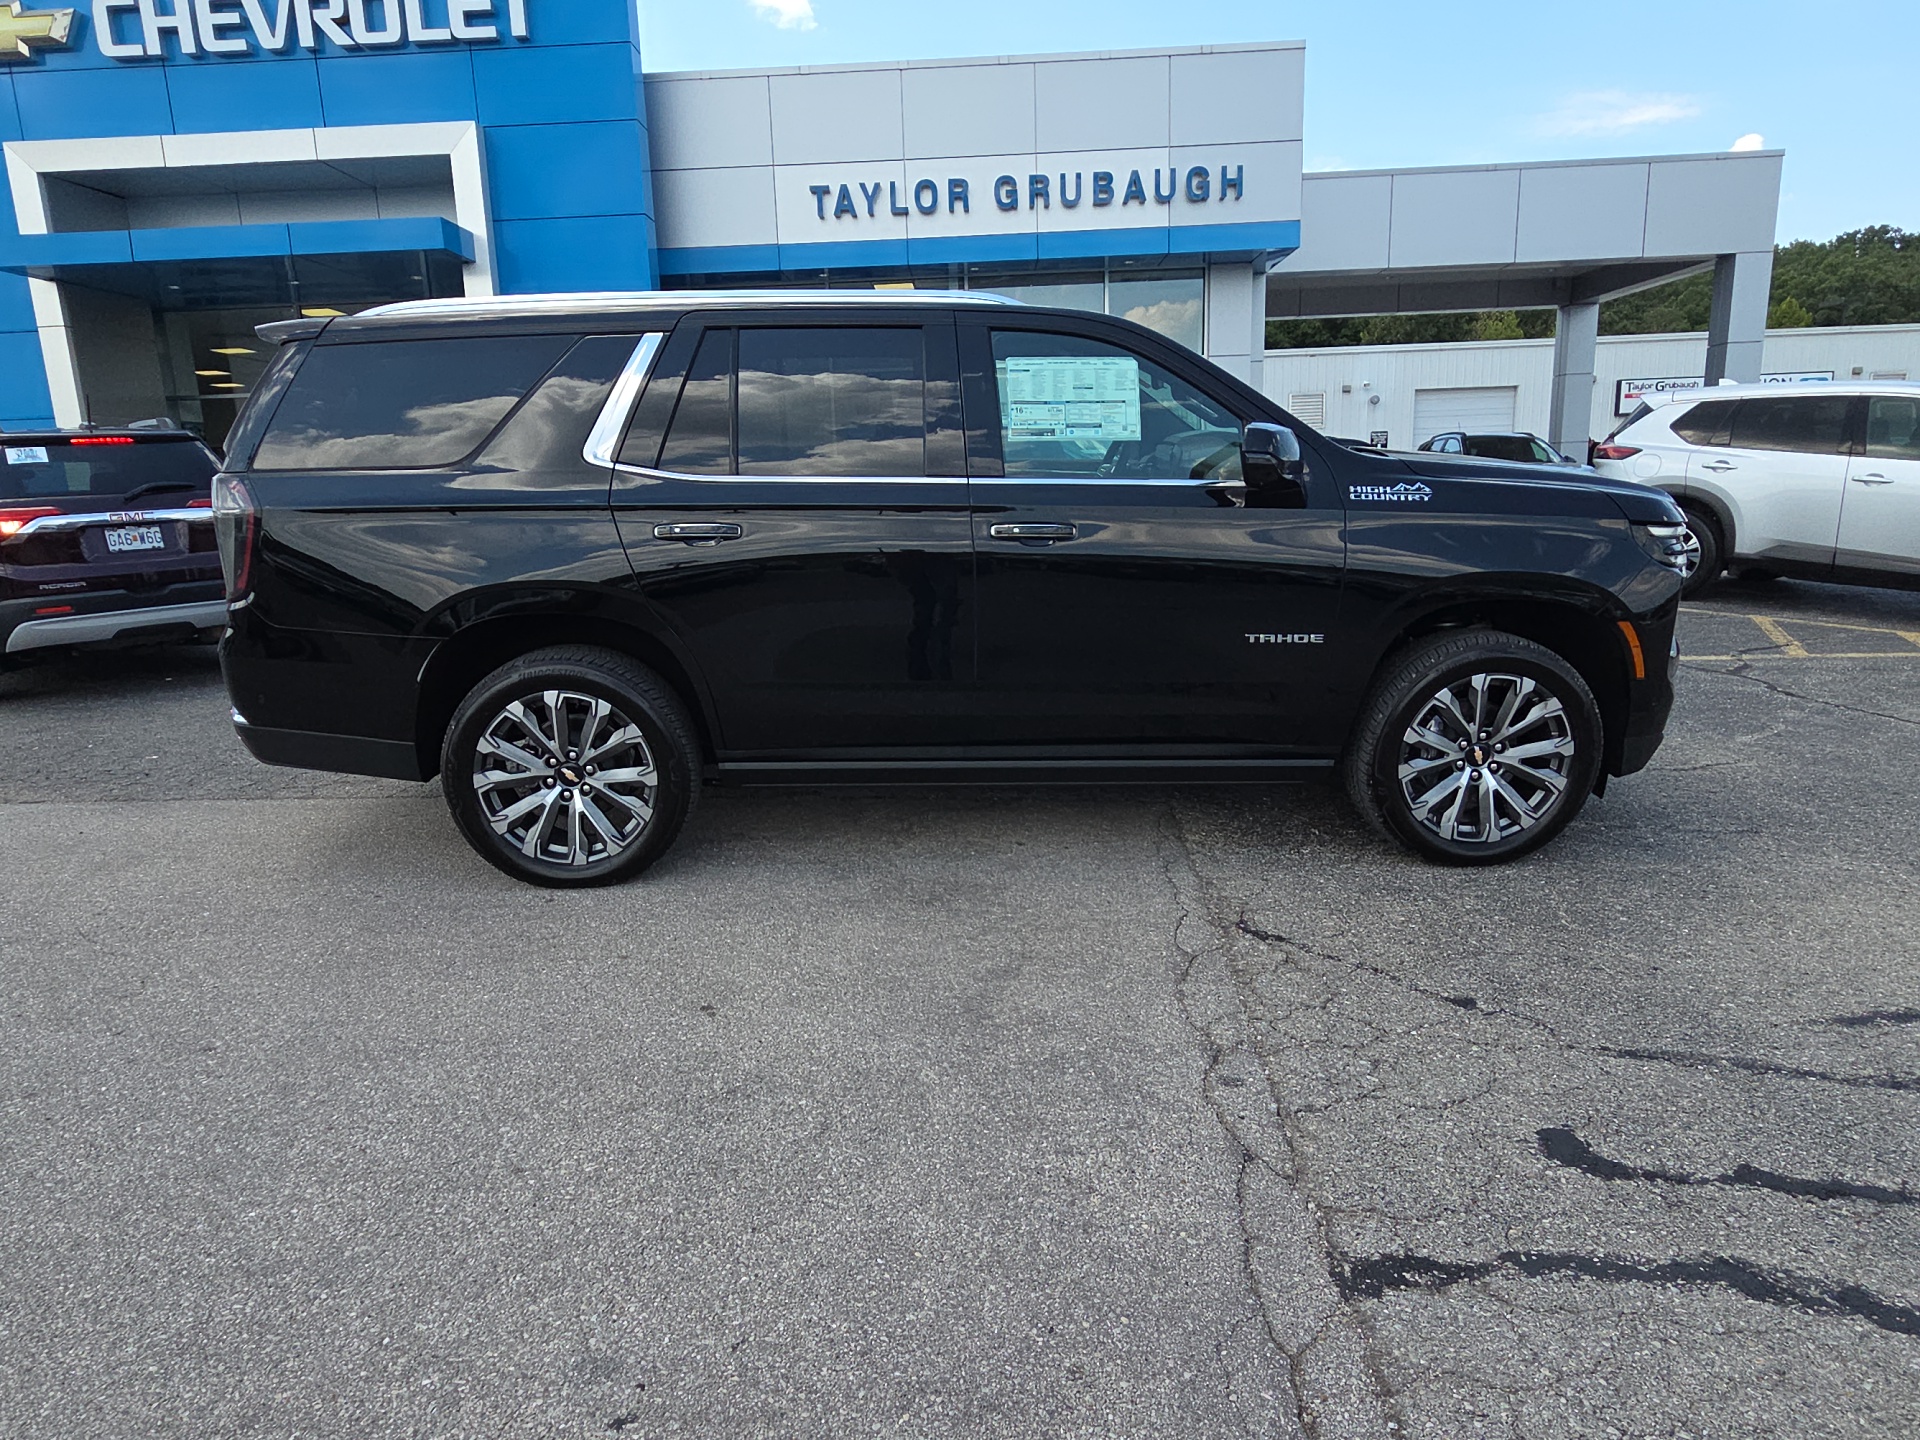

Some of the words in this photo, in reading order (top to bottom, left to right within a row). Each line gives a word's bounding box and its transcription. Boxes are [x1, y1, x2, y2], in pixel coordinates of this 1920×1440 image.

[92, 0, 527, 57] CHEVROLET
[809, 178, 970, 220] TAYLOR
[993, 164, 1244, 211] GRUBAUGH
[1625, 382, 1653, 392] Taylor
[1655, 381, 1699, 391] Grubaugh
[1349, 485, 1391, 493] HIGH
[1349, 493, 1433, 502] COUNTRY
[109, 511, 155, 522] GMC
[1245, 633, 1324, 643] TAHOE
